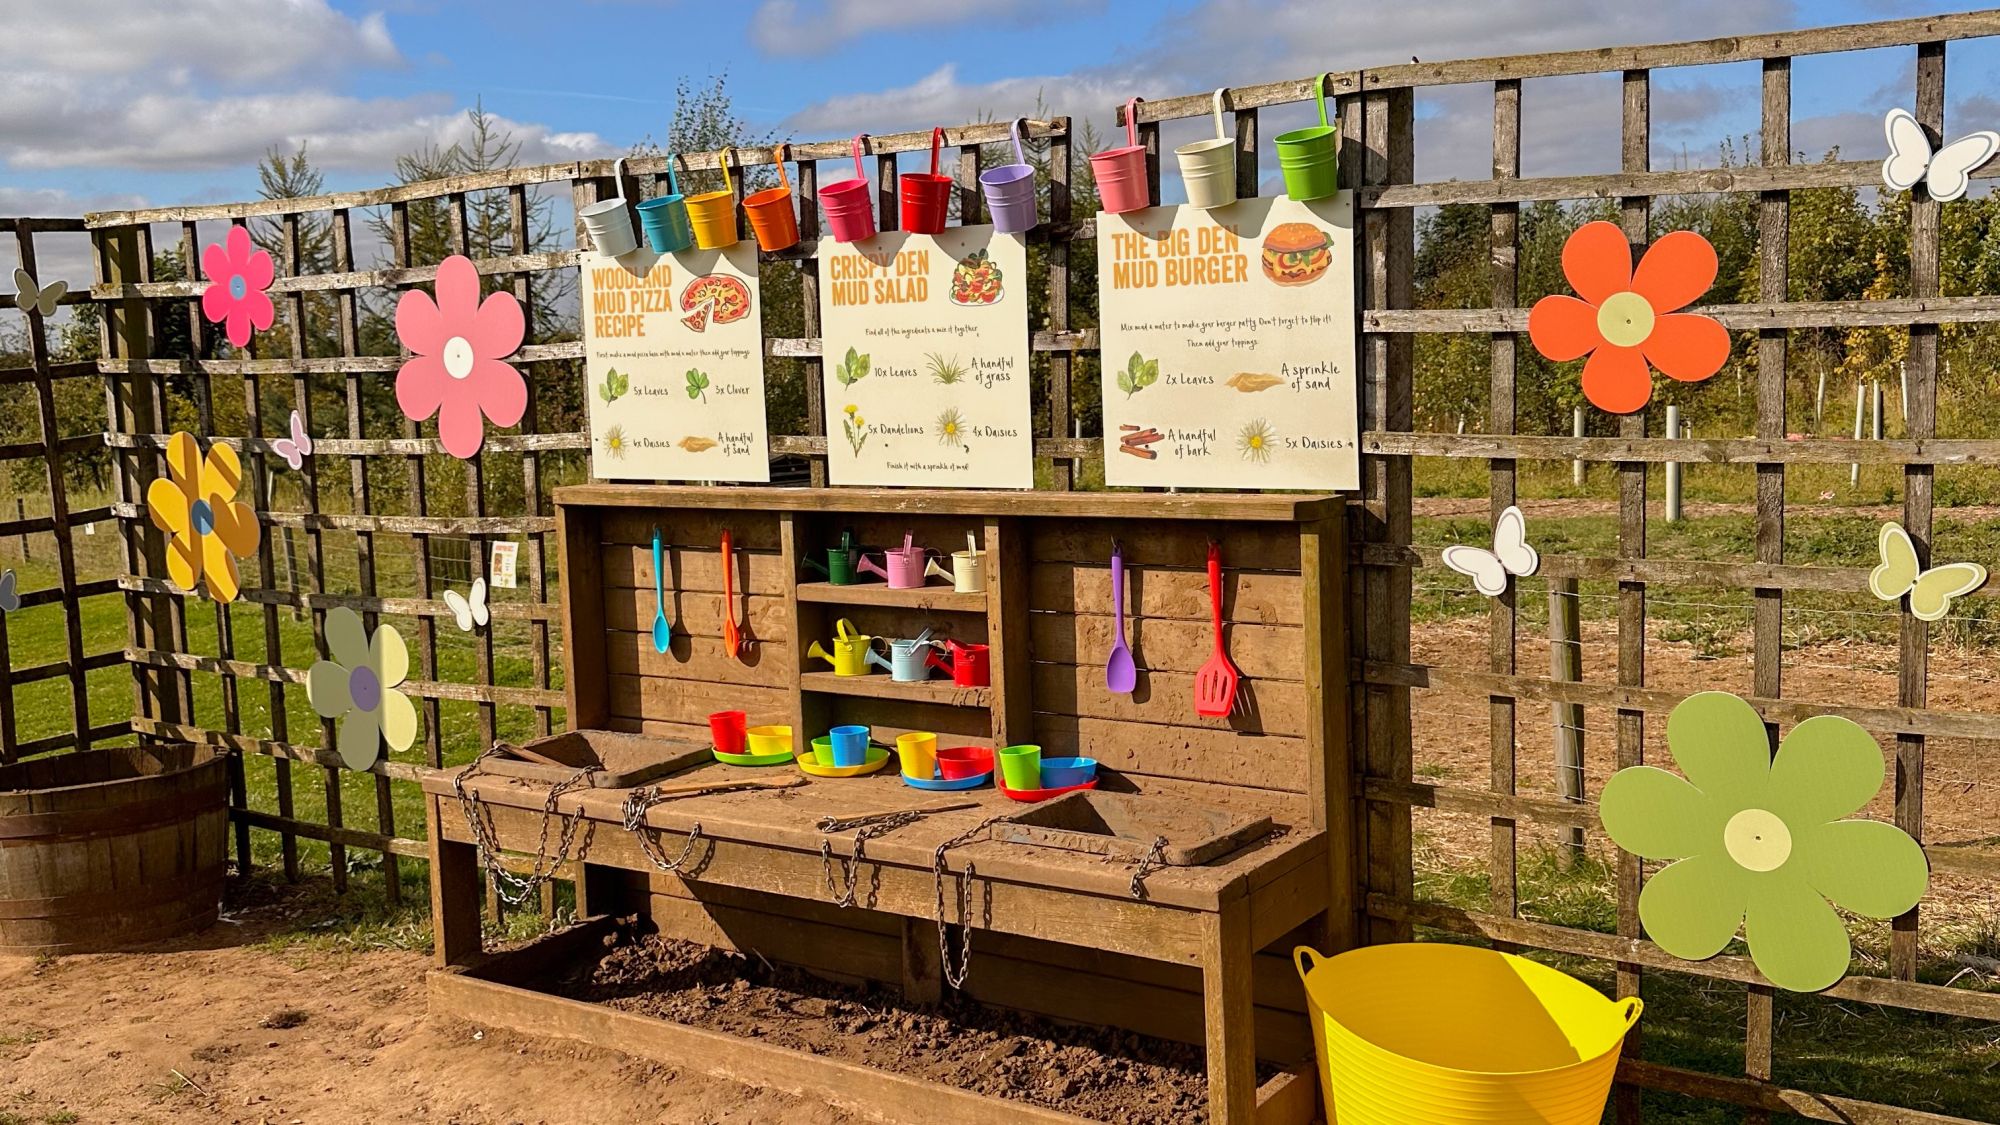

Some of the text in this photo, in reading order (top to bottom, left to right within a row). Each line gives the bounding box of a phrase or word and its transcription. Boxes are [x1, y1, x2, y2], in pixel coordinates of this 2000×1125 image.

[1112, 224, 1239, 260] THE BIG DEN
[830, 250, 930, 280] CRISPY DEN
[1113, 254, 1249, 289] MUD BURGER
[592, 265, 672, 290] WOODLAND
[832, 277, 929, 306] MUD SALAD
[593, 289, 672, 314] MUD PIZZA
[595, 314, 646, 338] RECIPE
[1120, 323, 1133, 331] Mix
[1134, 323, 1148, 332] mud
[1155, 321, 1172, 331] water
[1174, 320, 1181, 330] to
[1182, 320, 1200, 329] make
[1200, 320, 1215, 333] your
[1216, 319, 1236, 332] burger
[1278, 315, 1299, 330] forget
[1301, 315, 1308, 325] to
[1309, 315, 1321, 326] flip
[865, 328, 877, 336] Find
[884, 328, 890, 336] of
[891, 327, 900, 336] the
[901, 325, 931, 339] ingredients
[948, 325, 953, 334] it
[1187, 339, 1204, 348] Then
[1204, 338, 1215, 348] add
[1214, 339, 1230, 353] your
[659, 349, 670, 358] with
[719, 349, 730, 360] your
[971, 356, 1014, 371] A handful
[1281, 361, 1341, 379] A sprinkle
[874, 366, 918, 377] 10x Leaves
[1165, 373, 1215, 385] 2x Leaves
[975, 371, 1011, 389] of grass
[1291, 377, 1331, 393] of sand
[633, 386, 669, 396] 5x Leaves
[715, 384, 750, 395] 3x Clover
[868, 424, 924, 435] 5x Dandelions
[973, 425, 1018, 437] 4x Daisies
[1168, 428, 1216, 445] A handful
[643, 437, 671, 448] Daisies
[718, 432, 754, 445] A handful
[1285, 436, 1343, 449] 5x Daisies
[723, 445, 751, 457] of sand
[1174, 445, 1212, 460] of bark
[886, 461, 903, 470] Finish
[903, 461, 909, 471] it
[910, 462, 922, 471] with
[927, 461, 948, 472] sprinkle
[949, 462, 955, 471] of
